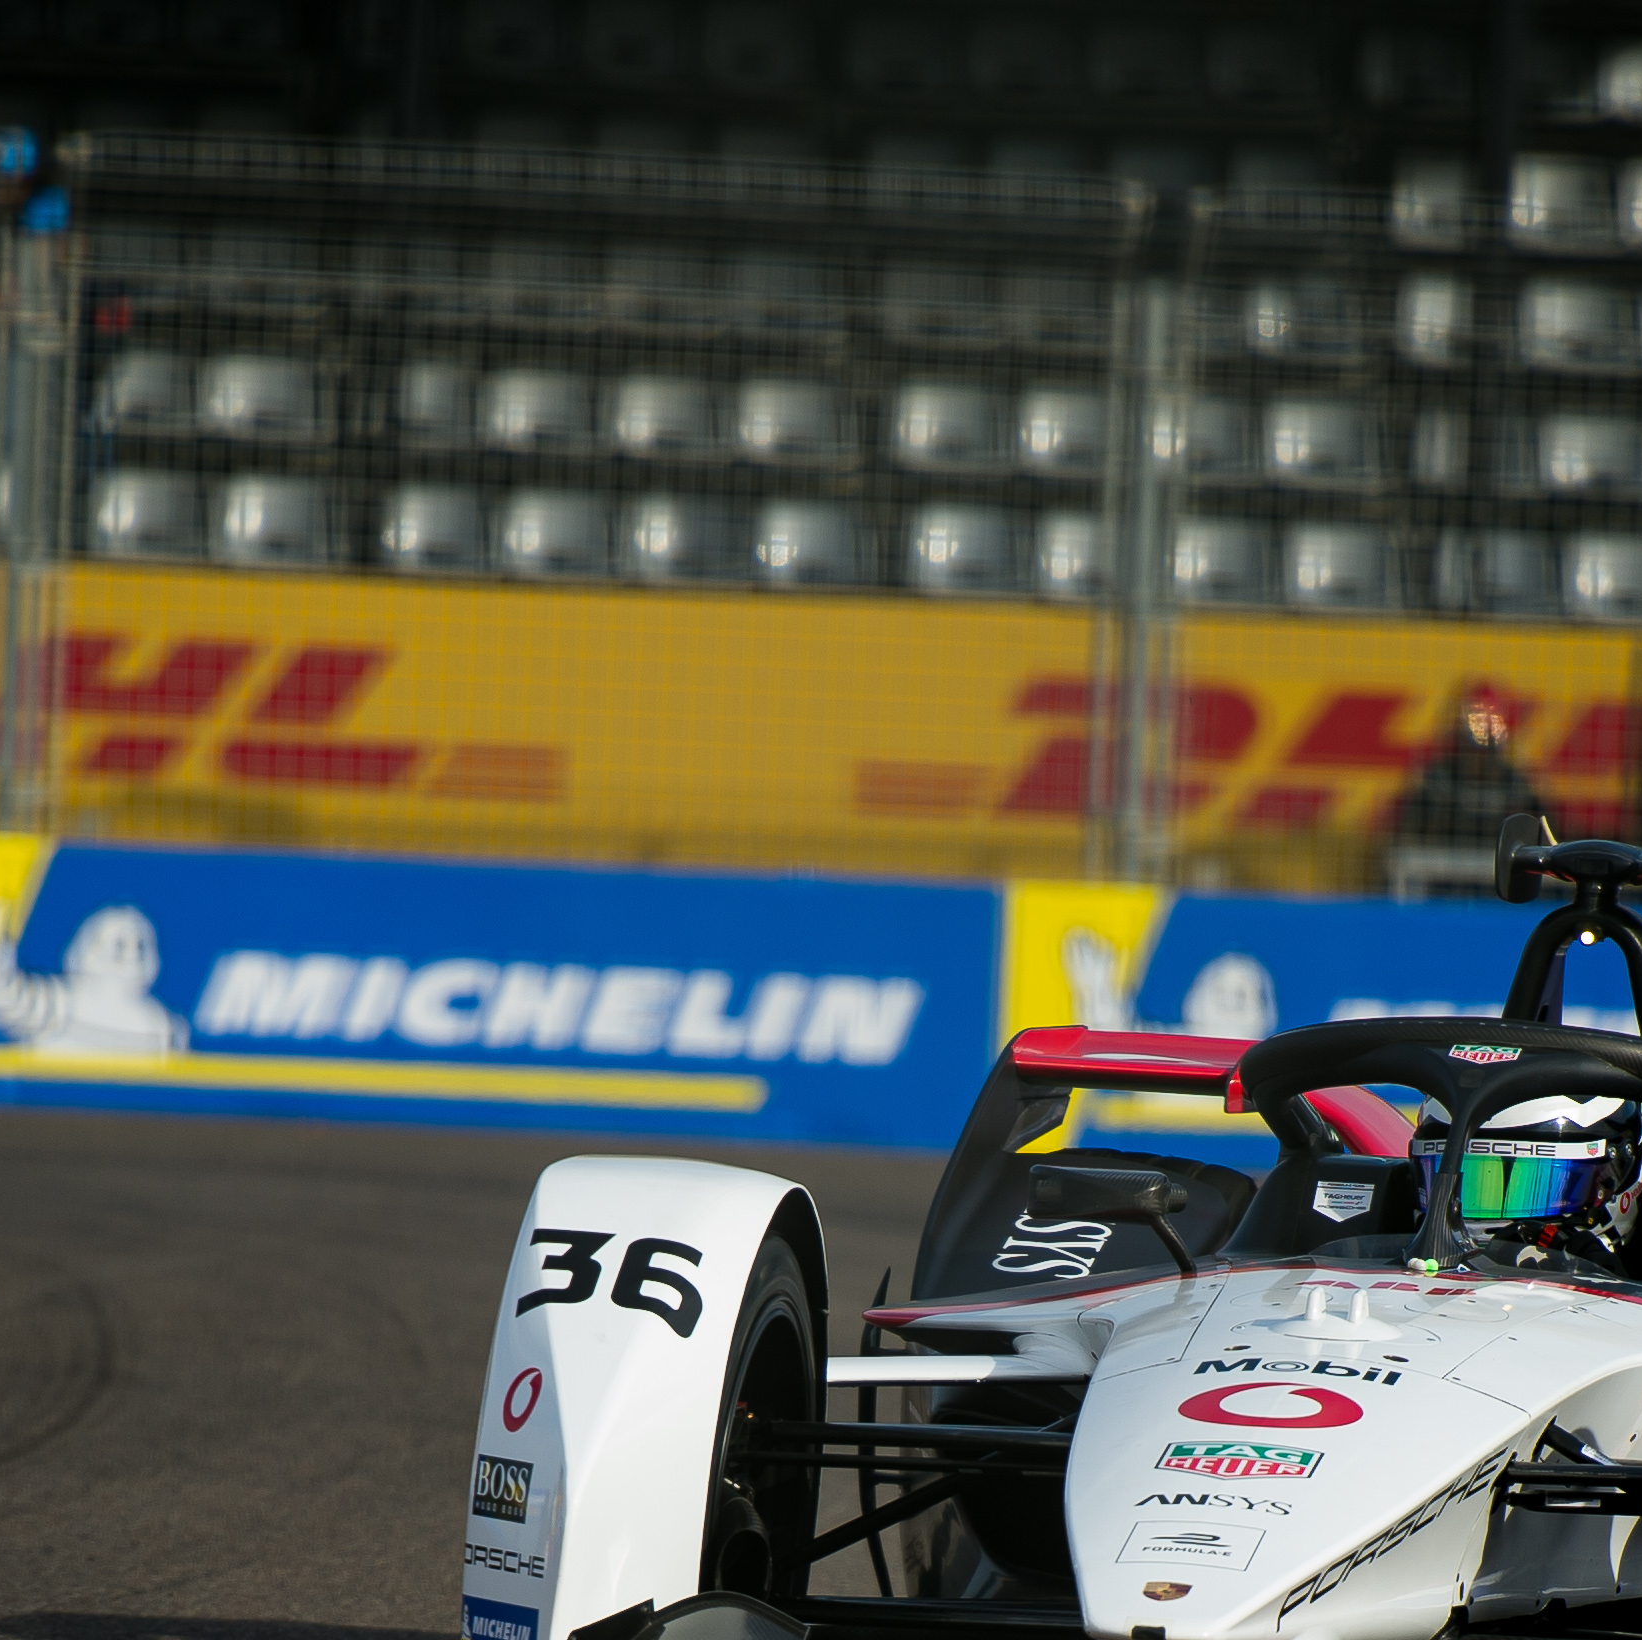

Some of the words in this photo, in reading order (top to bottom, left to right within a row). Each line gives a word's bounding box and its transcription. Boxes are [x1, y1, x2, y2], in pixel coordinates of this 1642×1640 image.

[193, 949, 926, 1066] MICHELIN
[1423, 1141, 1556, 1156] POSCHE
[991, 1212, 1113, 1279] SYS
[515, 1228, 703, 1339] 36
[1193, 1357, 1402, 1386] Mobil
[1169, 1457, 1301, 1476] HEUER
[1182, 1444, 1304, 1464] TAG
[476, 1460, 529, 1503] BOSS
[1133, 1493, 1293, 1516] ANSYS
[1275, 1446, 1509, 1634] PORSCHE
